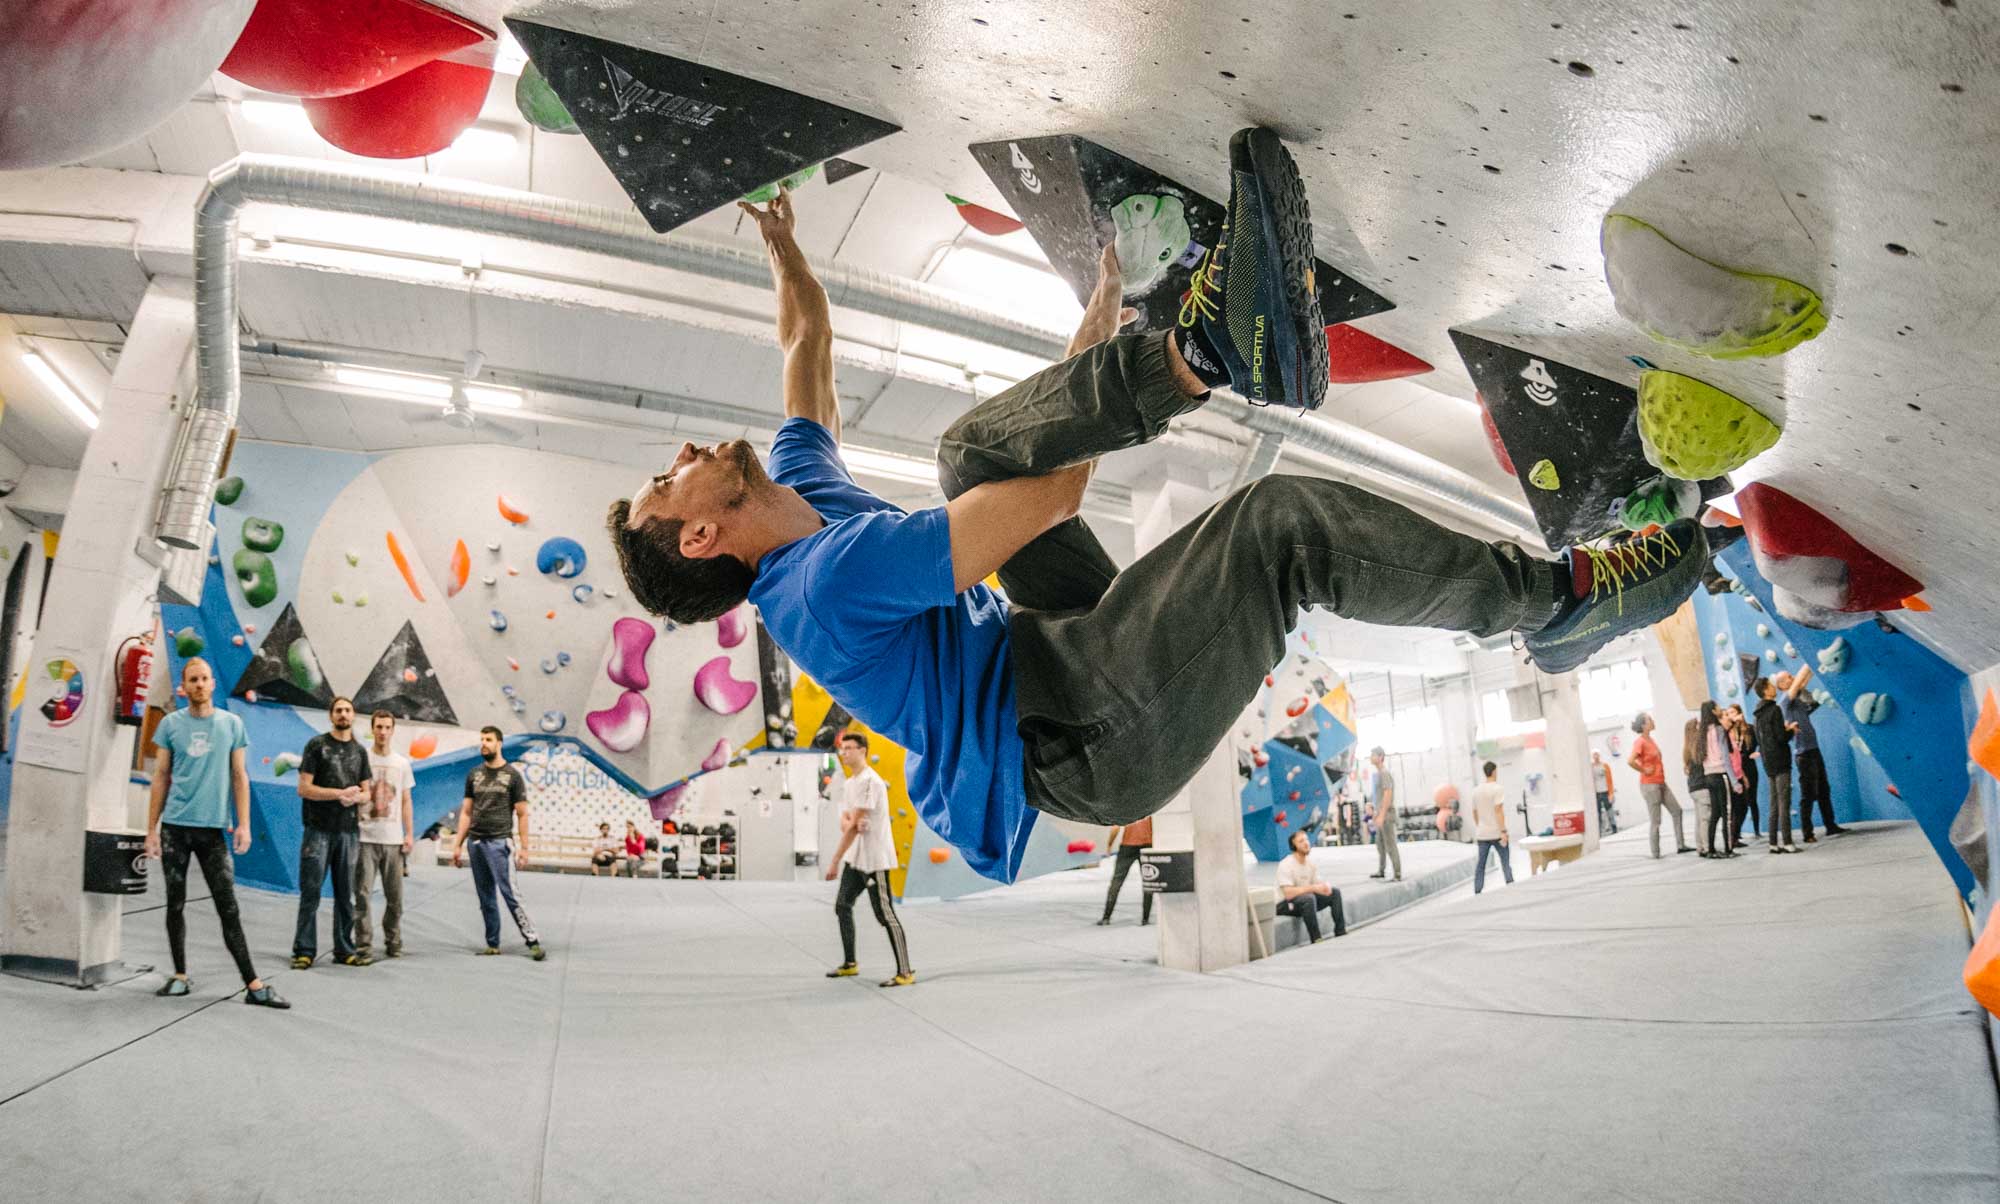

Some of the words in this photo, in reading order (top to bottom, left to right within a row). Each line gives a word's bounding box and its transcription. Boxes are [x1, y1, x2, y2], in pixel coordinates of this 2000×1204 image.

[1186, 331, 1220, 375] adidas
[1252, 315, 1265, 384] SPORTIVA
[1253, 386, 1263, 398] LA
